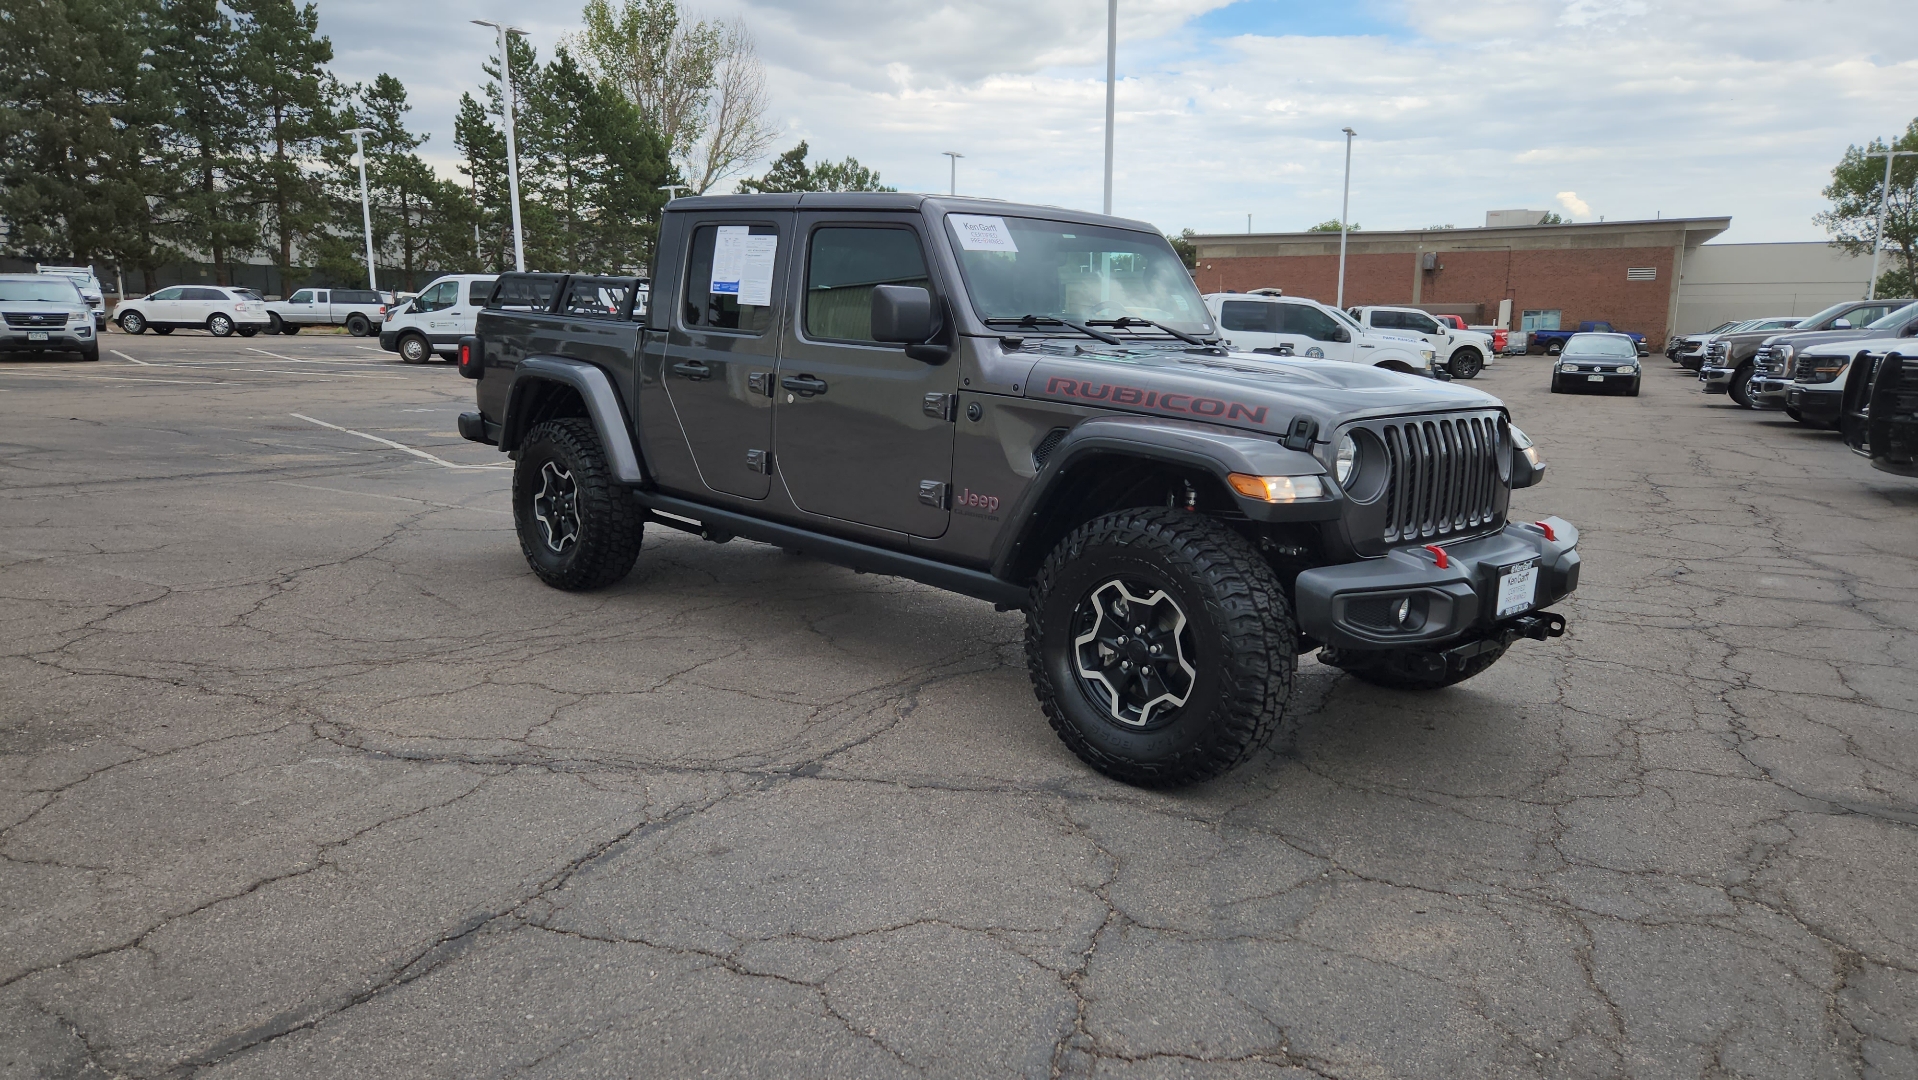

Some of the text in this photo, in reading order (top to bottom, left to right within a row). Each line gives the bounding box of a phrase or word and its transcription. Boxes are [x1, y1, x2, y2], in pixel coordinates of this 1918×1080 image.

[963, 222, 998, 232] Ken Garff
[1045, 376, 1269, 424] RUBICON
[957, 488, 1000, 513] Jeep
[954, 508, 1000, 522] GLADIATOR
[1507, 575, 1517, 586] Ken
